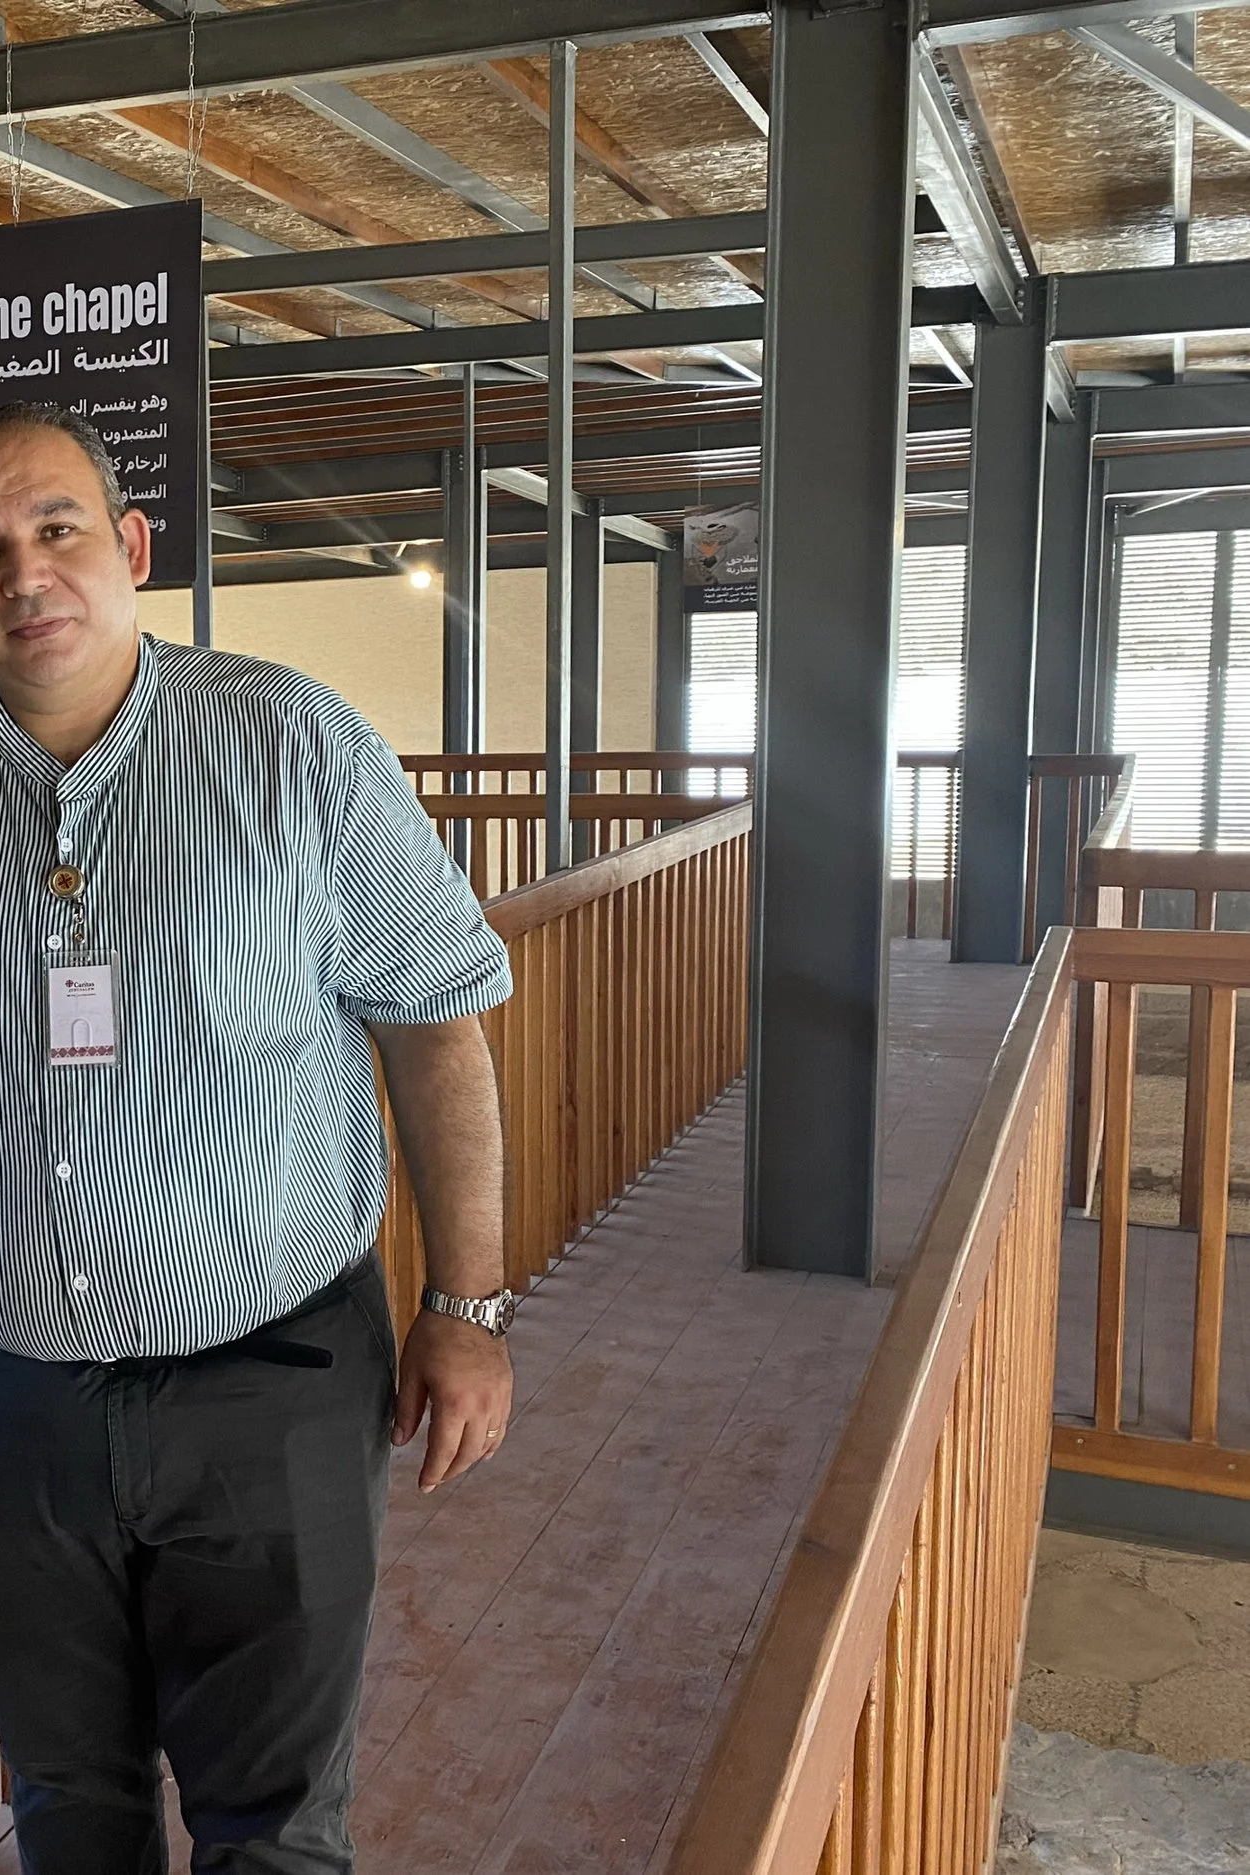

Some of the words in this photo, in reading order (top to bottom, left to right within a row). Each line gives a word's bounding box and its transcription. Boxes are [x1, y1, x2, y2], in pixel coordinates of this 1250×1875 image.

[43, 271, 168, 336] chapel
[73, 338, 169, 373] الكنيسة
[91, 397, 137, 416] ينقسم
[141, 394, 168, 413] وهو
[102, 423, 168, 445] المتعبدون
[124, 453, 167, 474] الرخام
[121, 483, 167, 504] القساو
